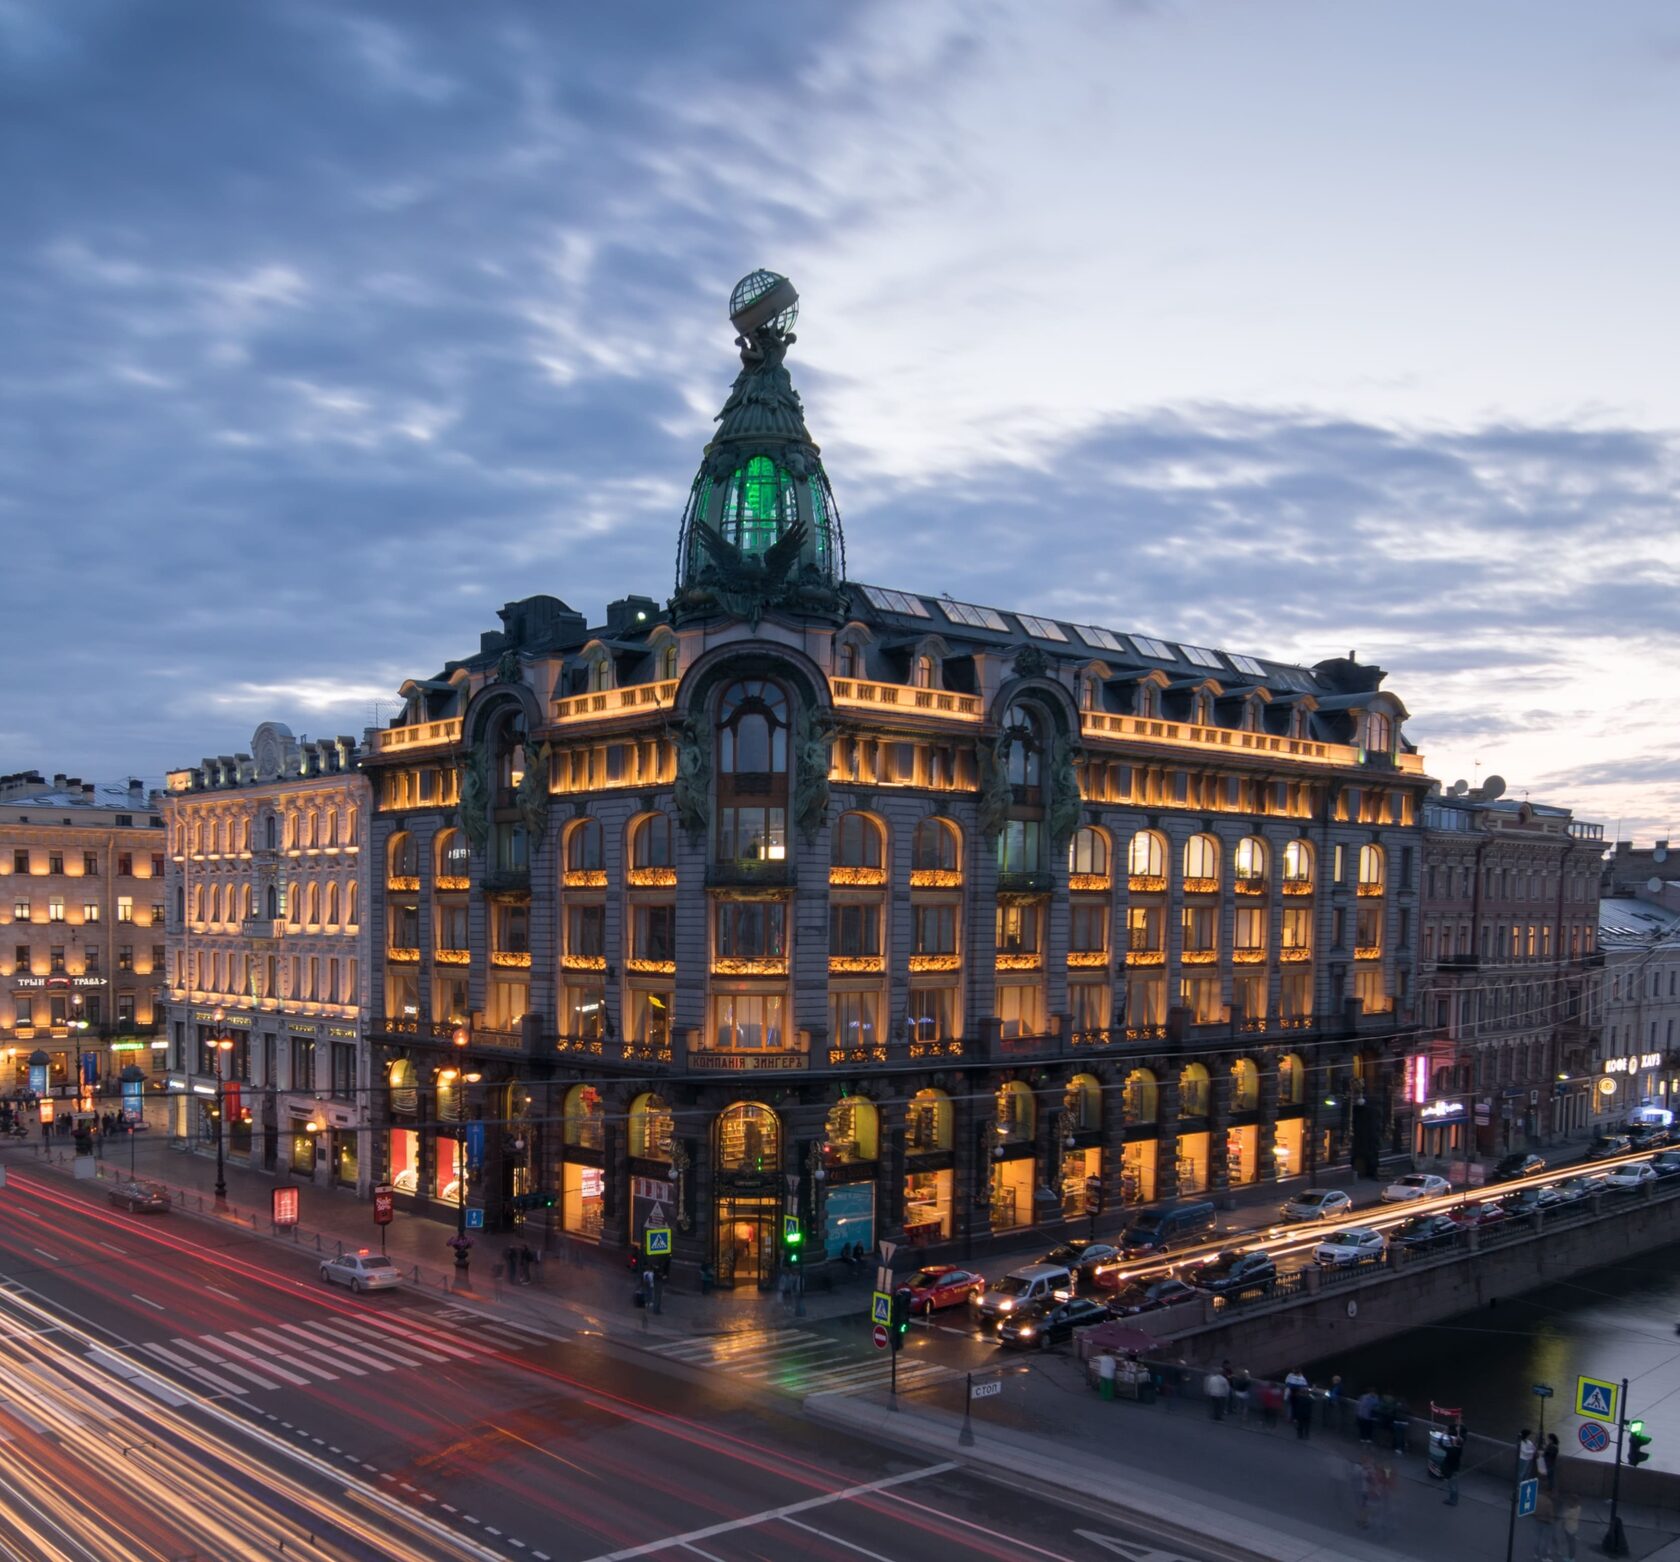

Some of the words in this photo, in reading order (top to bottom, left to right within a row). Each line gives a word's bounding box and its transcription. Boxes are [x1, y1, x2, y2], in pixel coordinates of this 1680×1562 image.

[18, 978, 45, 986] ТРЫН
[73, 978, 99, 986] ТРАВА
[693, 1057, 745, 1069] КОМПАНІЯ
[753, 1057, 802, 1069] ЗИНГЕРЪ
[1605, 1057, 1627, 1073] КОФЕ
[1641, 1053, 1660, 1068] ХАУЗ
[975, 1383, 997, 1396] СТОП
